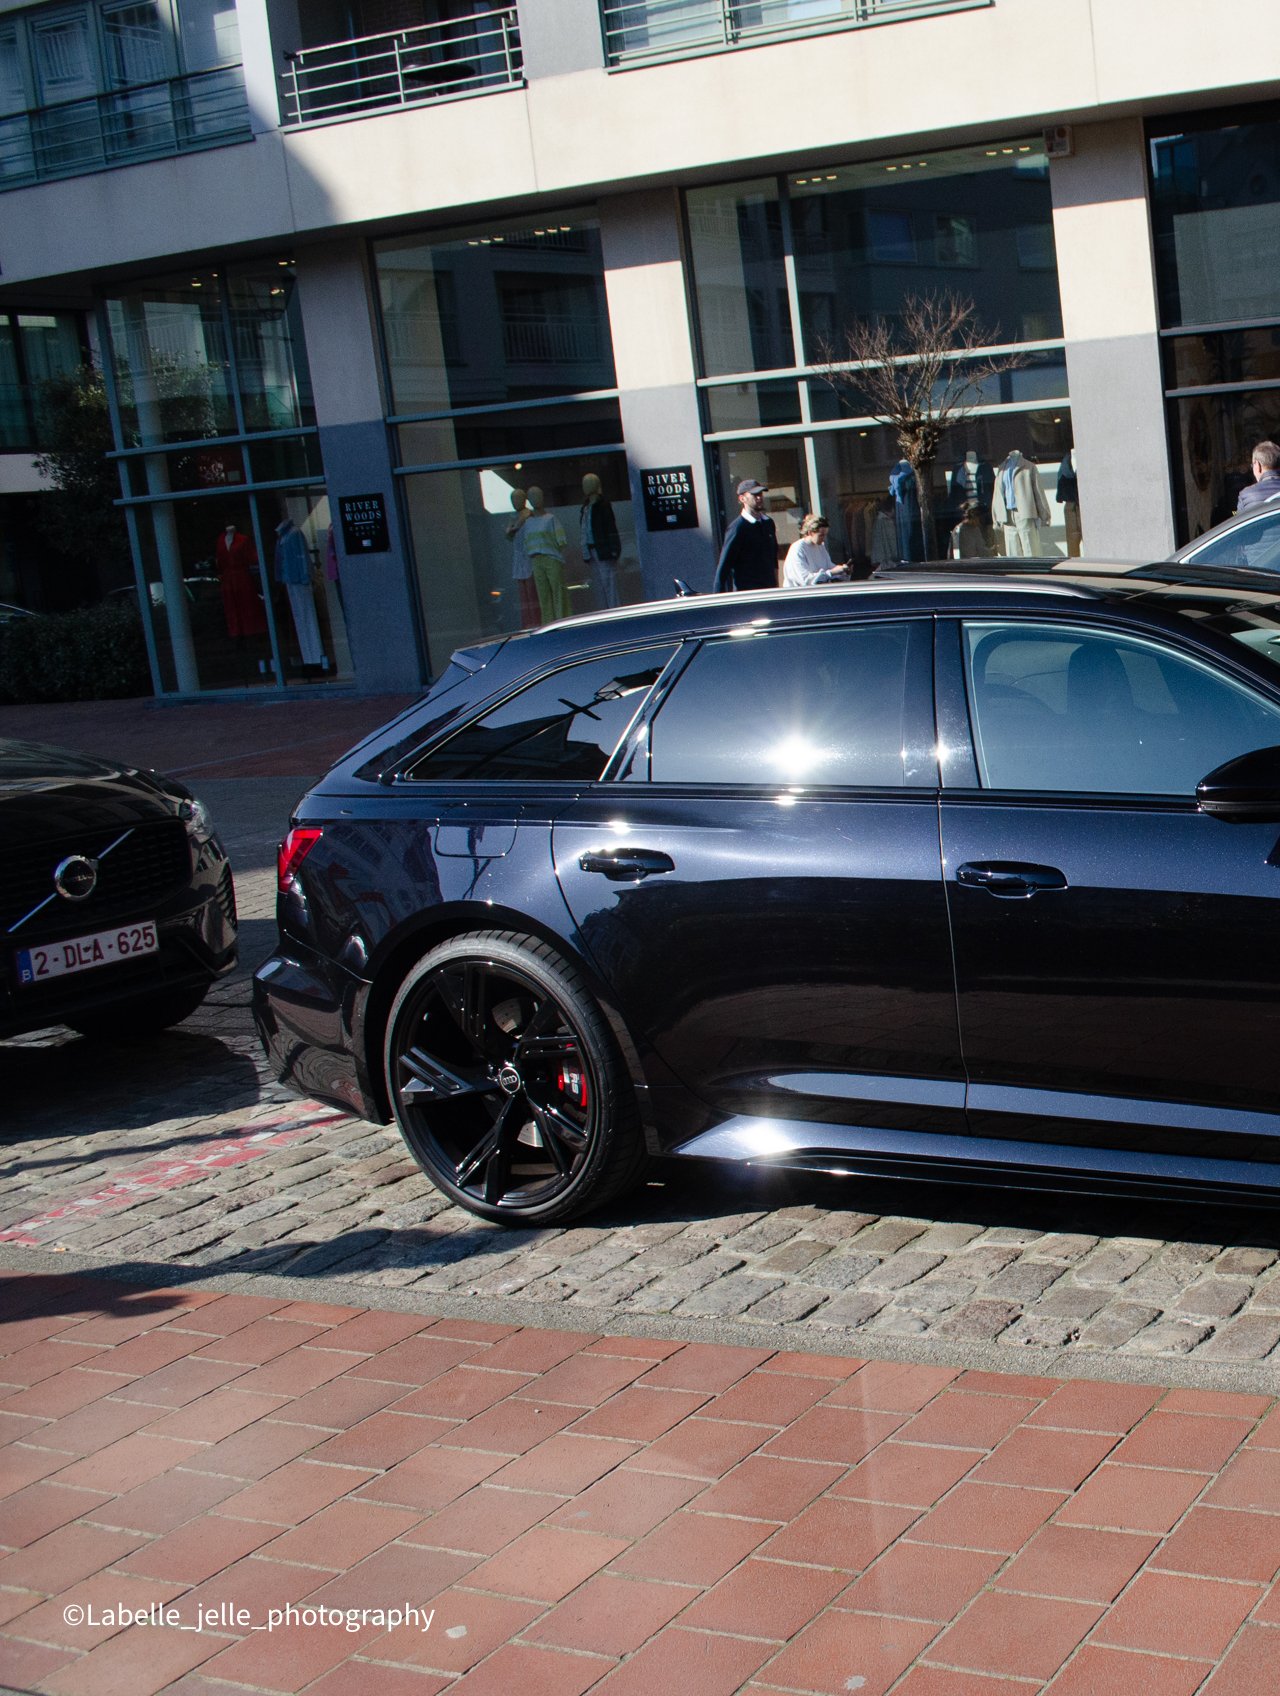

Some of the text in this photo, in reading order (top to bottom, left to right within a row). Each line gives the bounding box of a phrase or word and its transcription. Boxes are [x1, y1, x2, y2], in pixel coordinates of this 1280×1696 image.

[647, 472, 687, 485] RIVER
[647, 482, 690, 495] WOODS
[345, 500, 379, 512] RIVER
[345, 510, 382, 521] WOODS
[22, 969, 31, 981] B
